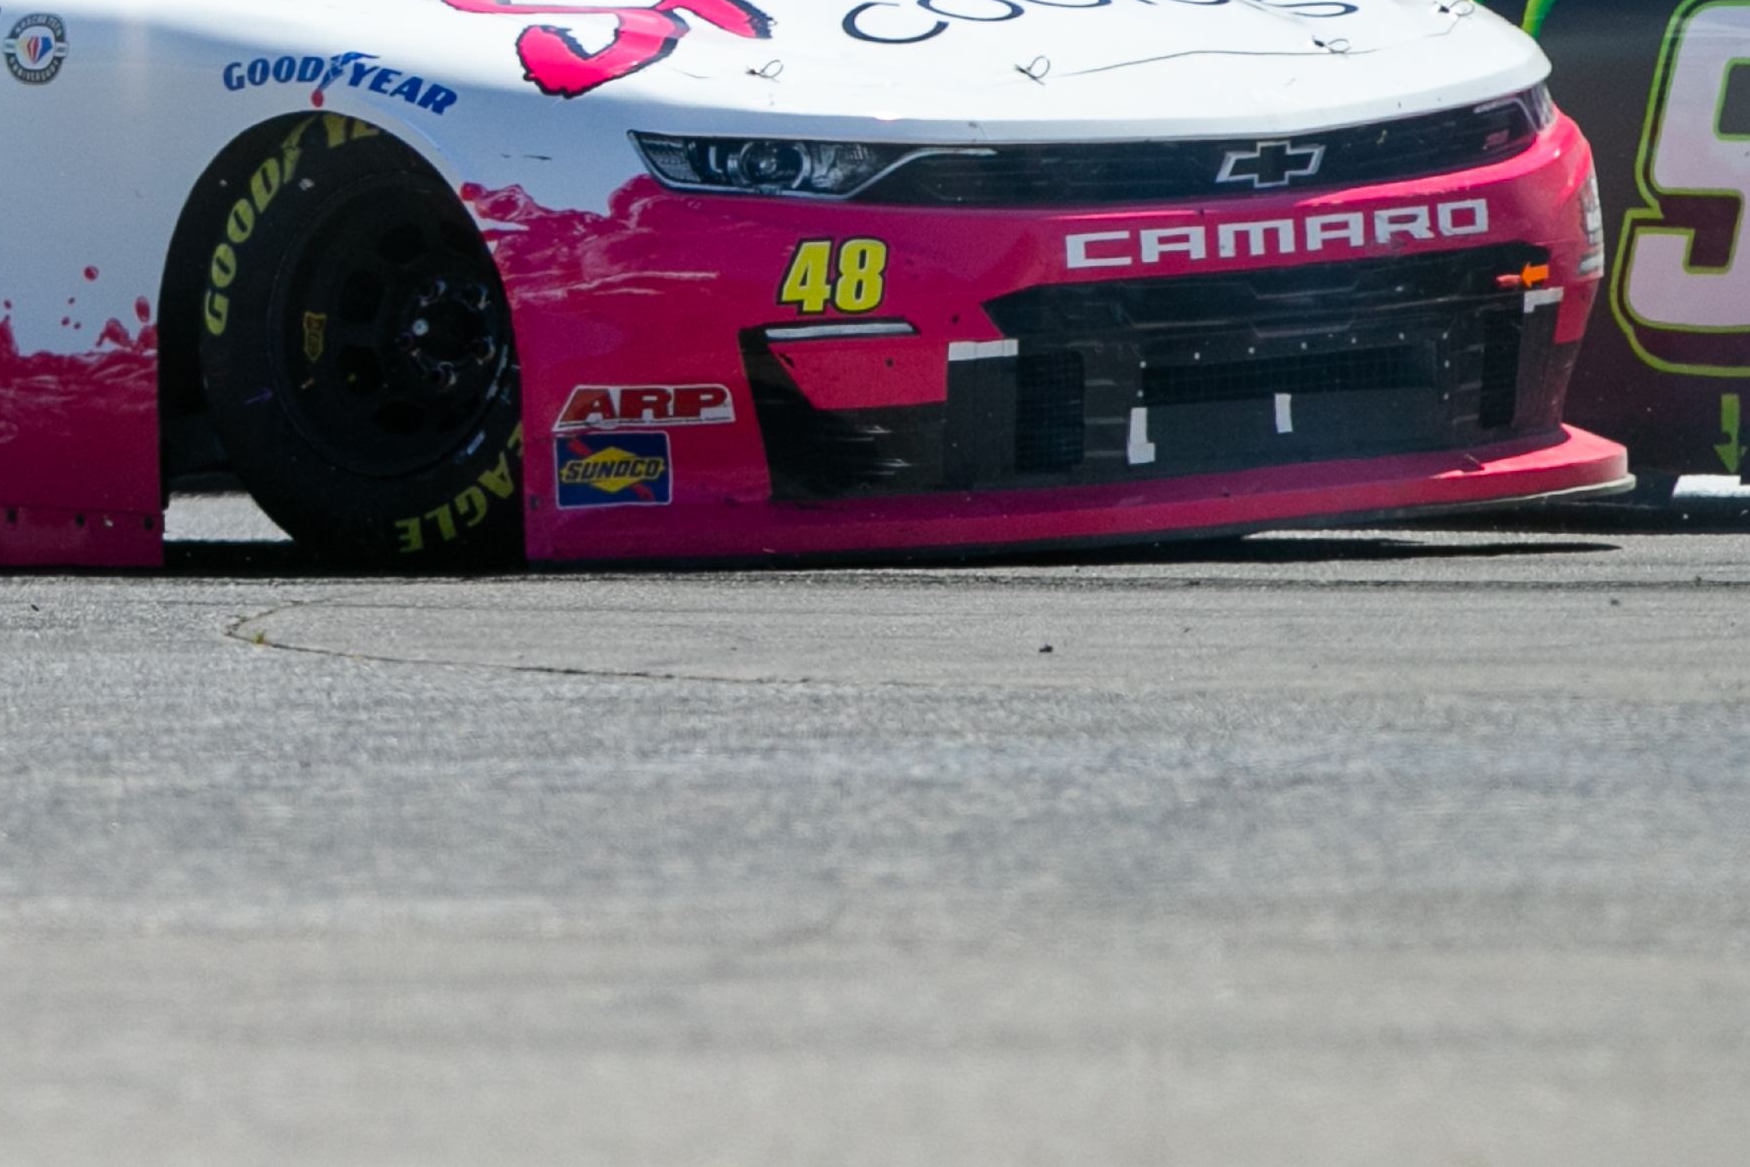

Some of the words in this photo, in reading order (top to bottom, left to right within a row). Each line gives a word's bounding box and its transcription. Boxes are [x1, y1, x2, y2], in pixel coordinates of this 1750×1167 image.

[223, 53, 458, 116] GOODYEAR
[1065, 198, 1489, 270] CAMARO
[775, 238, 888, 314] 48
[559, 387, 728, 422] ARP
[566, 458, 662, 481] SUNOCO
